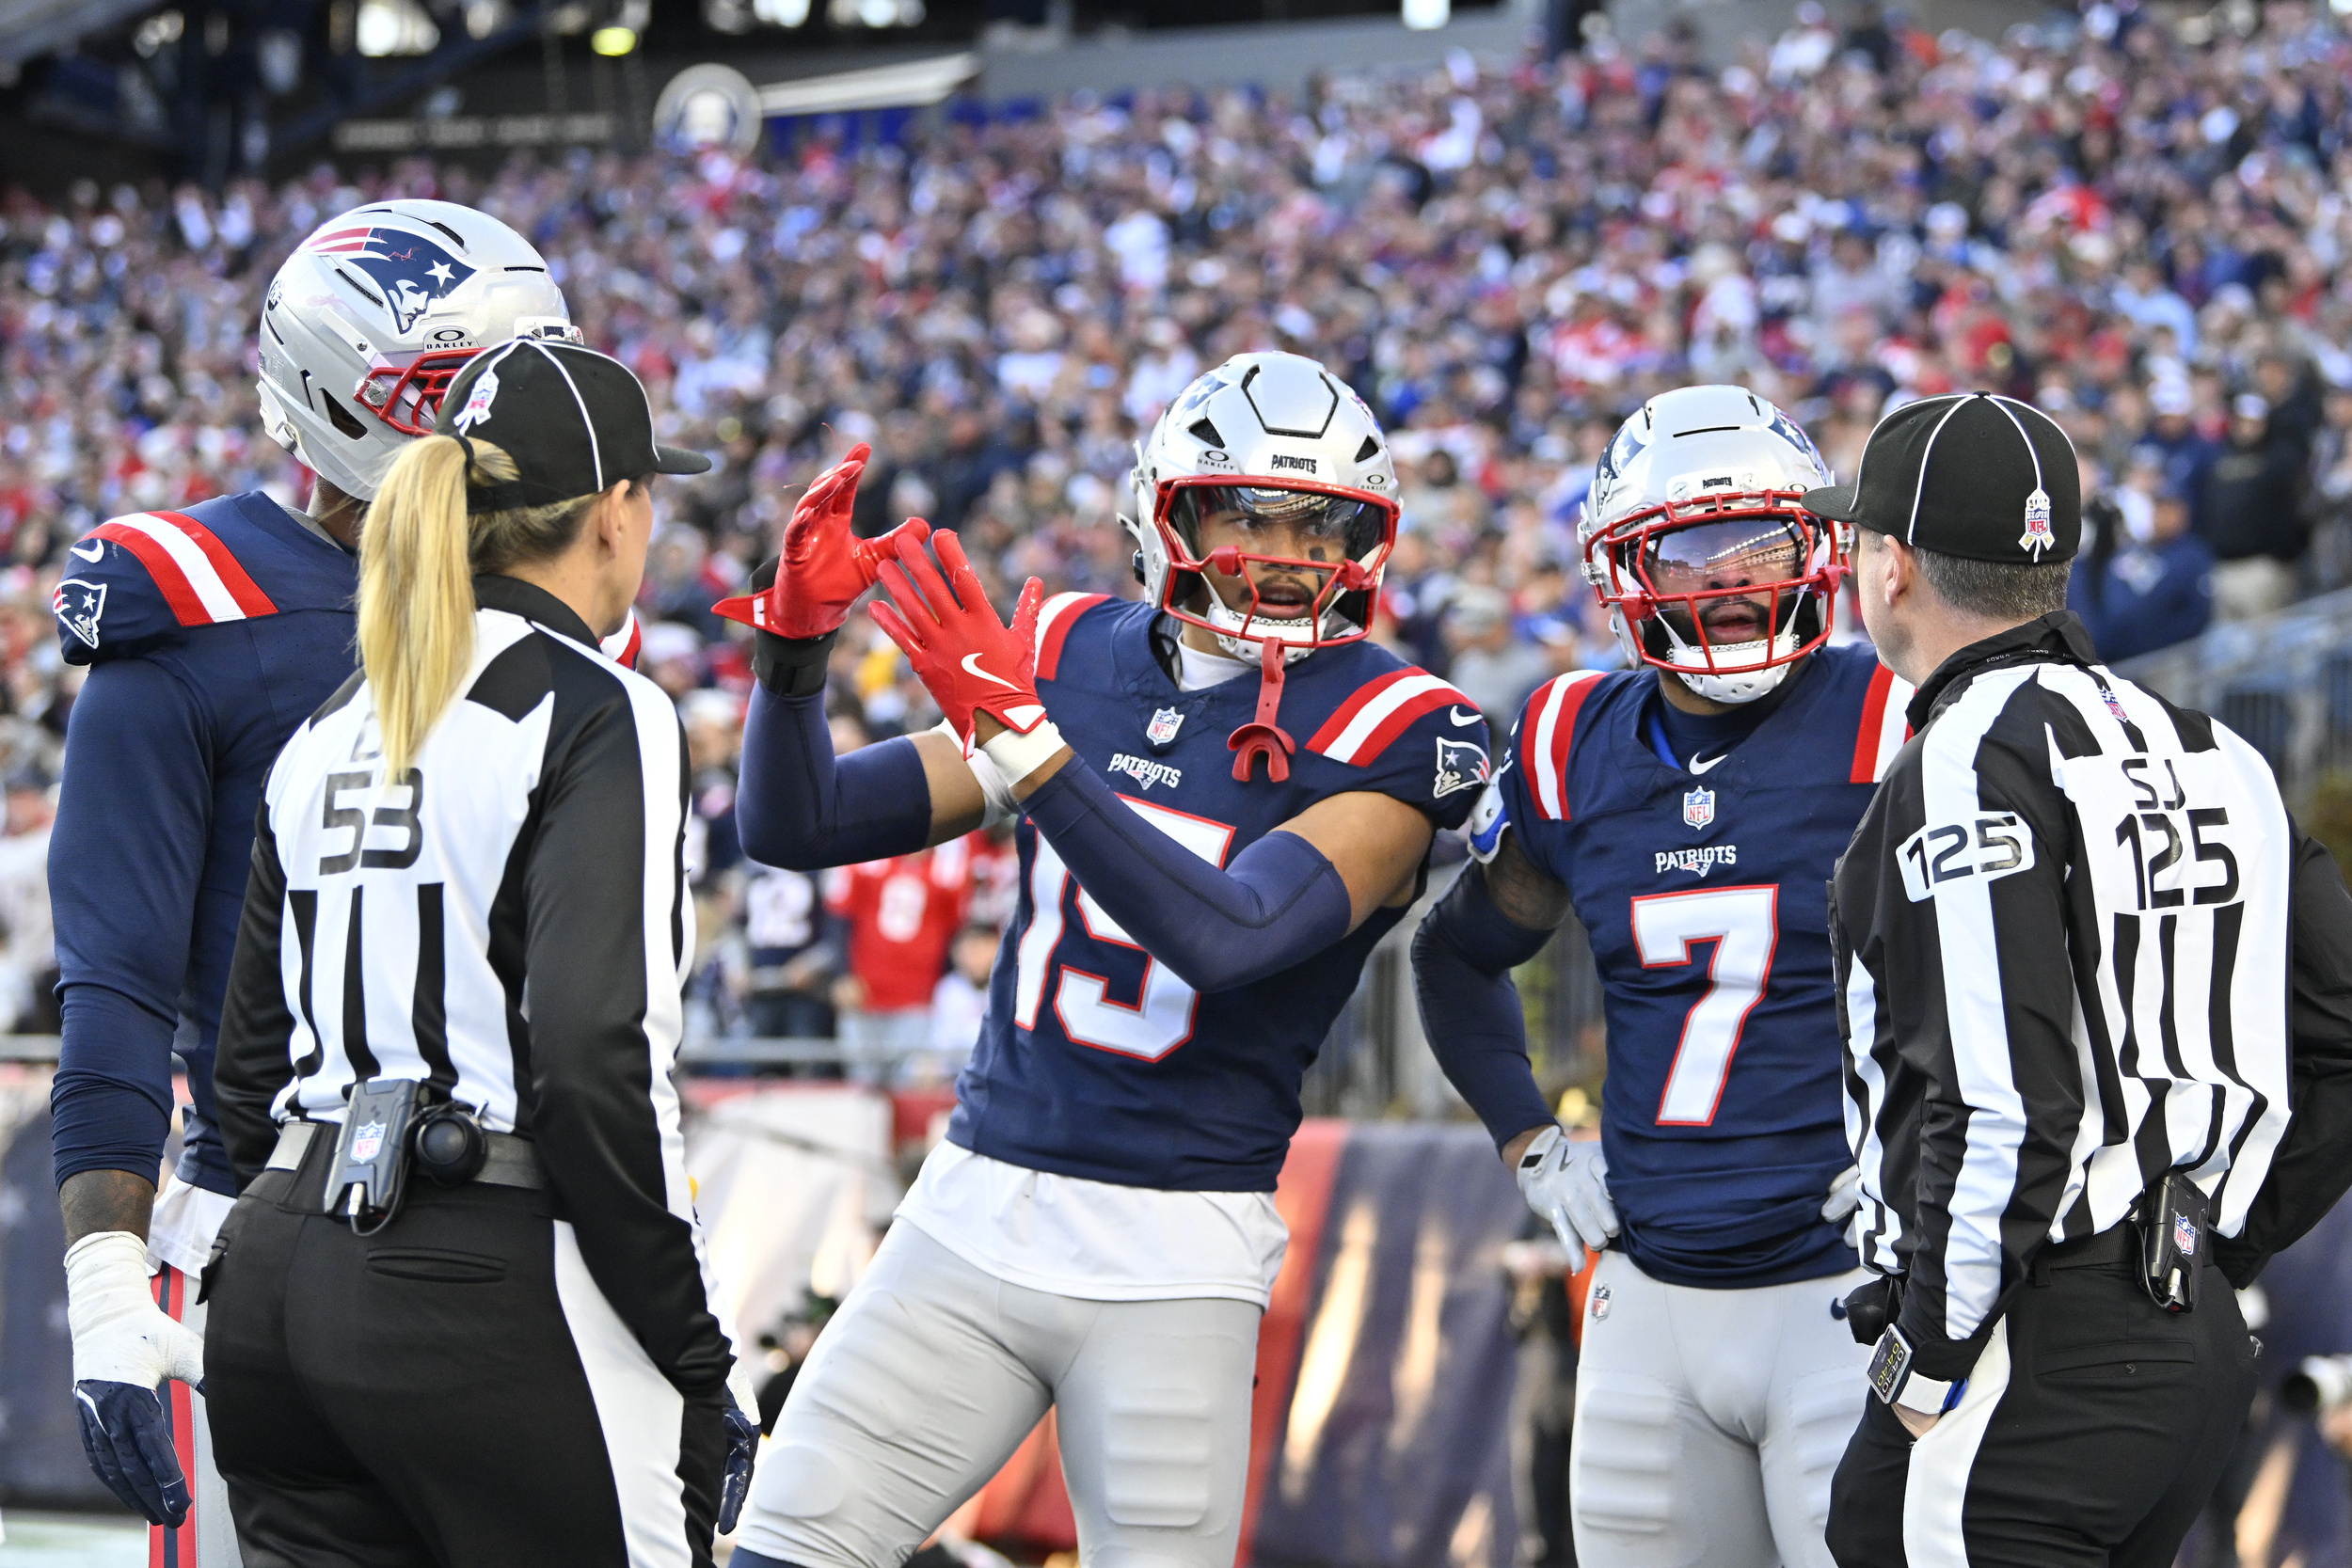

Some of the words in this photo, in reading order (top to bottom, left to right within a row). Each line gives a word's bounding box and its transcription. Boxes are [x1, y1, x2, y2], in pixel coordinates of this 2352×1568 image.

[426, 341, 474, 350] OAKLEY
[1198, 459, 1234, 470] OAKLEY
[1271, 453, 1317, 474] PATRIOTS
[1702, 476, 1733, 489] PATRIOTS
[2028, 520, 2046, 533] NFL
[1152, 722, 1170, 737] NFL
[1107, 753, 1182, 788] PATRIOTS
[2122, 758, 2185, 810] SJ
[319, 768, 423, 876] 53
[1689, 805, 1708, 822] NFL
[1655, 845, 1737, 874] PATRIOTS
[1906, 816, 2023, 891] 125
[2115, 807, 2240, 911] 125
[1014, 792, 1236, 1063] 15
[1630, 884, 1779, 1127] 7
[355, 1139, 375, 1157] NFL
[2176, 1227, 2191, 1250] NFL
